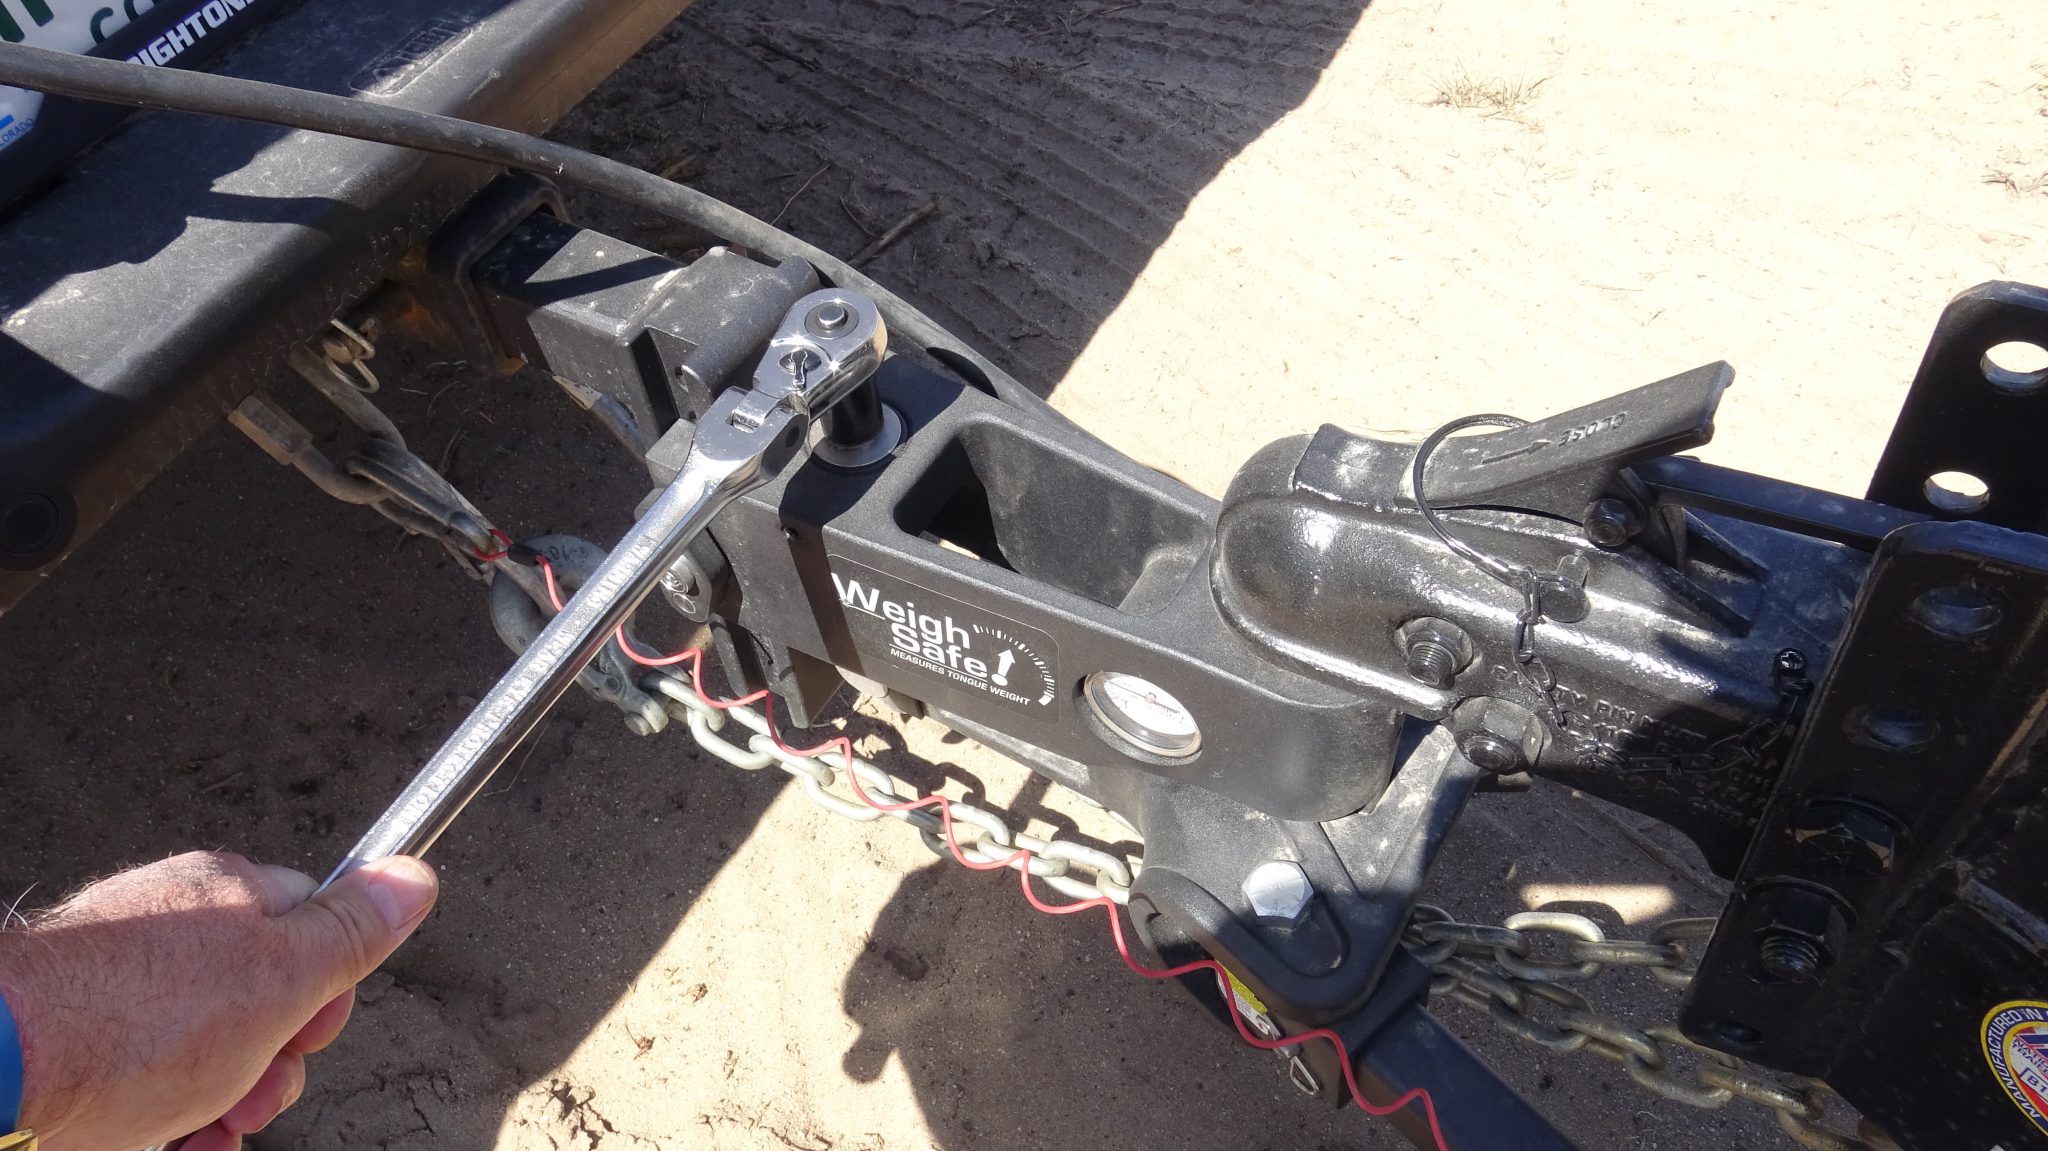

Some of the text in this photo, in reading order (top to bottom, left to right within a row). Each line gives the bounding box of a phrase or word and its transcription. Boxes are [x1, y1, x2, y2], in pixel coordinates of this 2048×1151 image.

[1558, 411, 1627, 447] CLOSE
[831, 572, 970, 649] Weigh
[890, 648, 1031, 706] MEASURES TONGUE WEIGHT
[1987, 1008, 2044, 1119] MANUFACTURED IN
